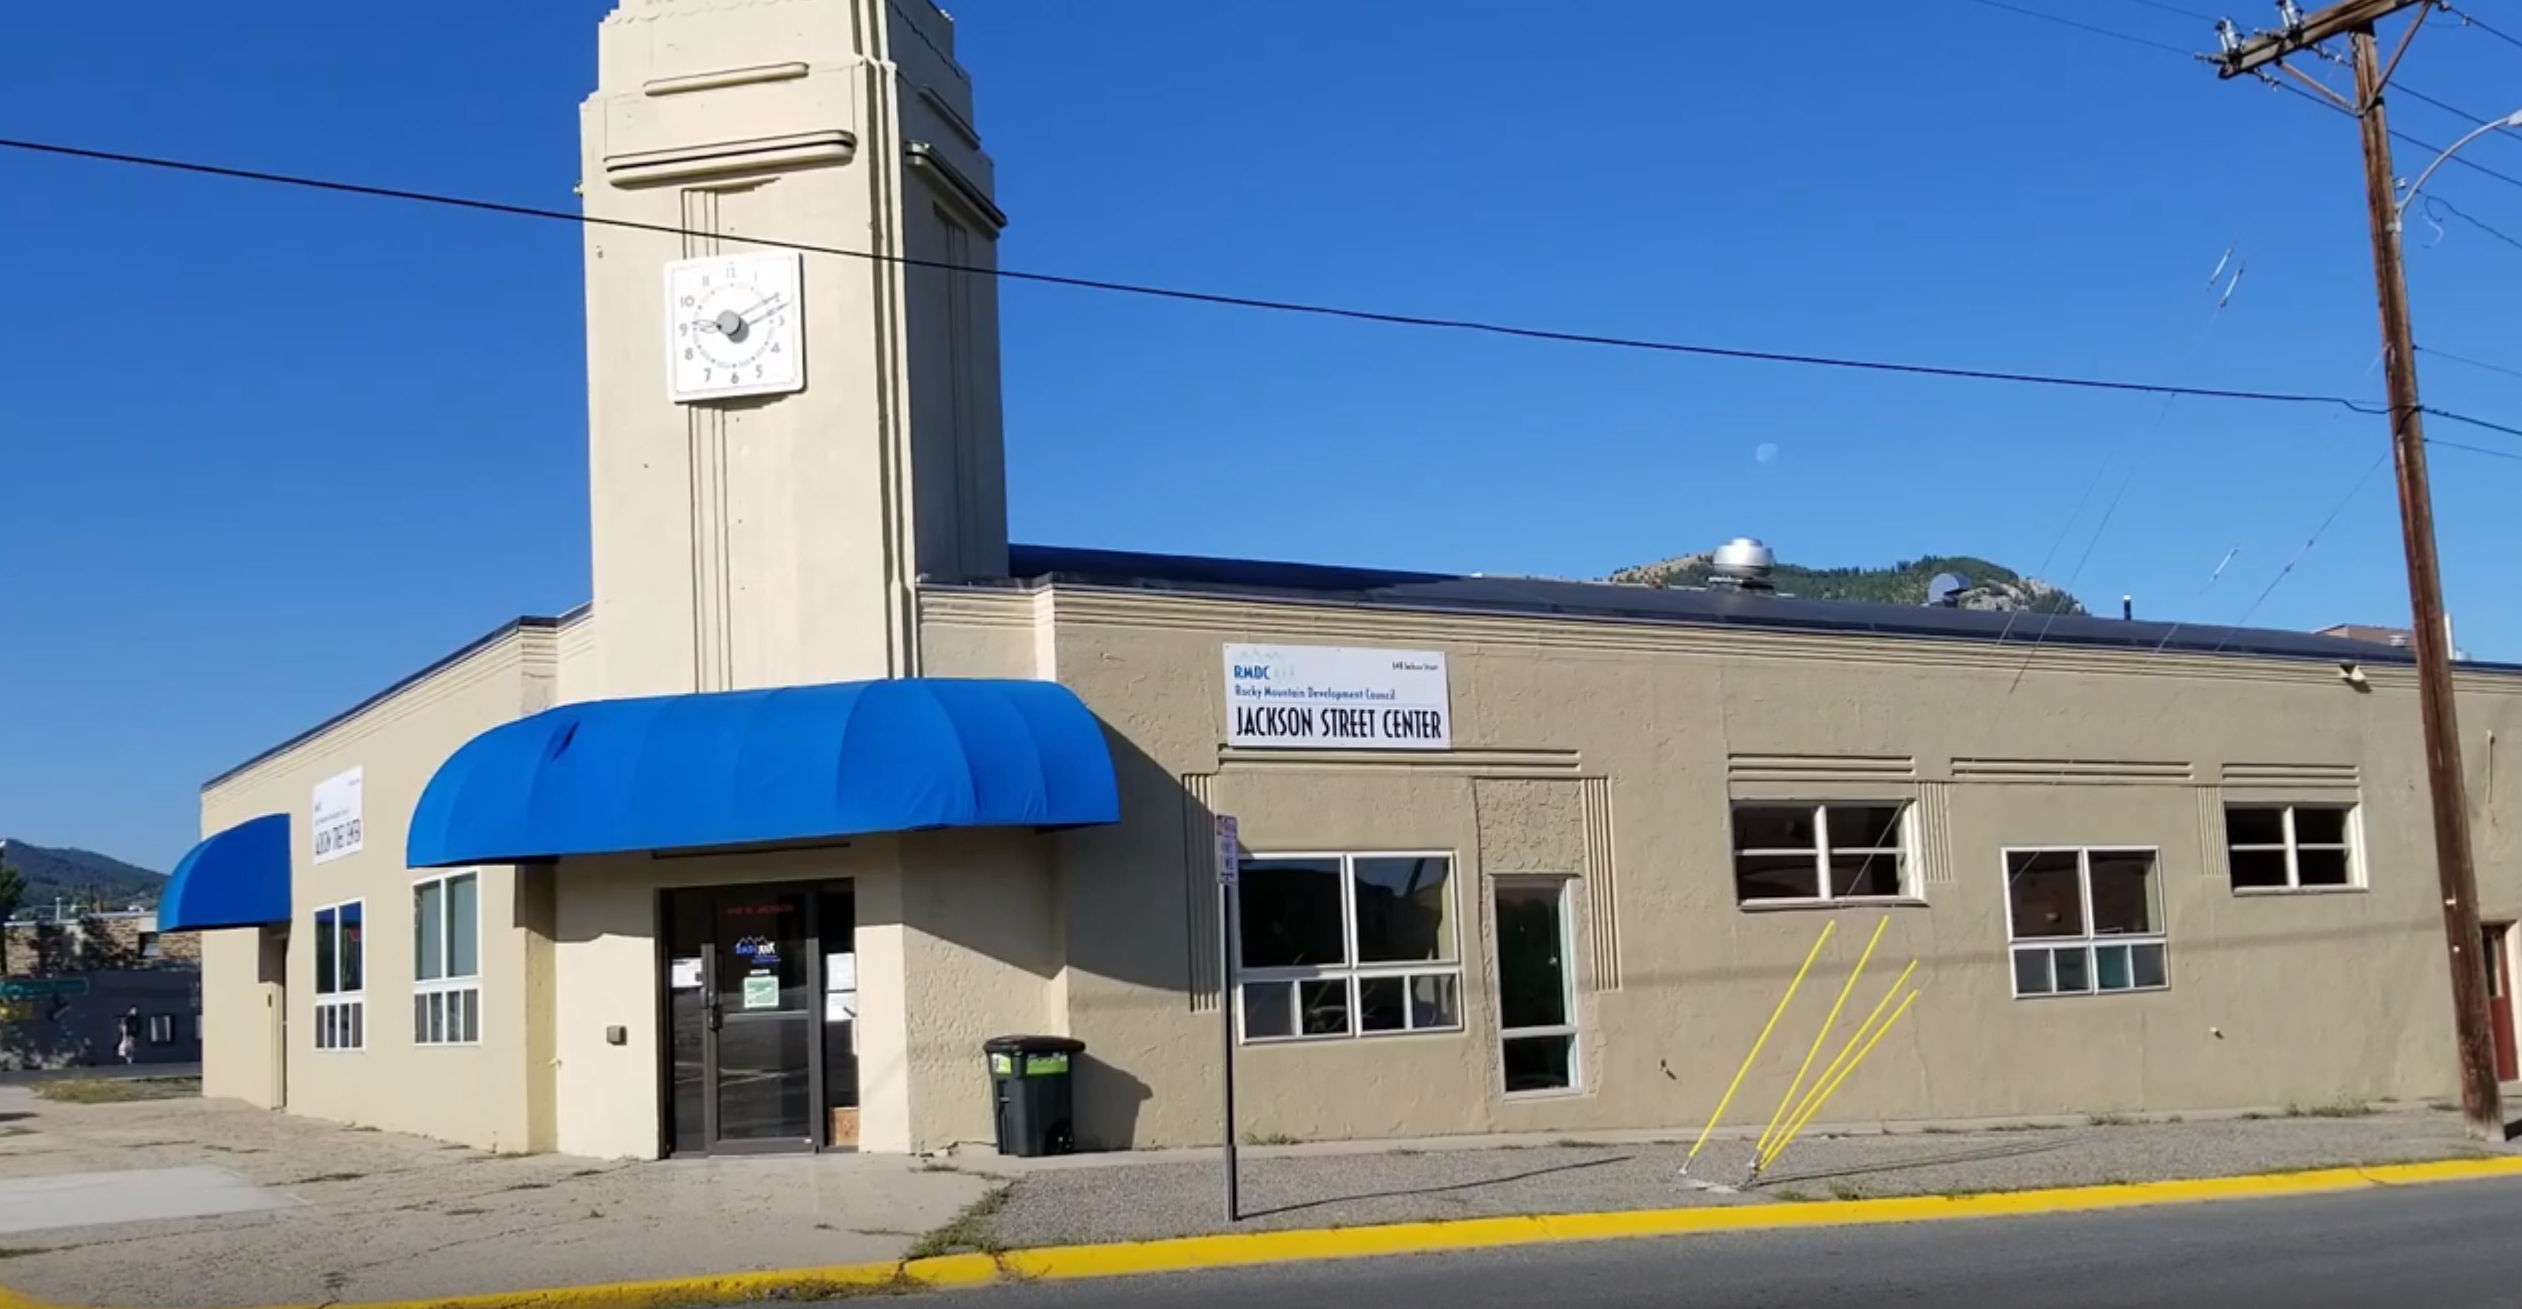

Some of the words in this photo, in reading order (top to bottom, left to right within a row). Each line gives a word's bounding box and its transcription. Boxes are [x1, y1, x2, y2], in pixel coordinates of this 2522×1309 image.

[726, 266, 737, 279] 12
[680, 295, 695, 308] 10
[778, 315, 786, 327] 3
[679, 323, 688, 337] 9
[684, 347, 694, 360] 8
[770, 342, 781, 354] 4
[703, 367, 712, 382] 7
[730, 371, 739, 384] 6
[755, 364, 764, 379] 5
[1234, 665, 1270, 680] RMDC
[1235, 684, 1262, 700] Rocky
[1264, 684, 1306, 699] Mountain
[1308, 686, 1363, 701] Development
[1365, 688, 1396, 701] Council
[1236, 706, 1314, 738] JACKSON
[1321, 708, 1376, 738] STREET
[1383, 709, 1442, 739] CENTER
